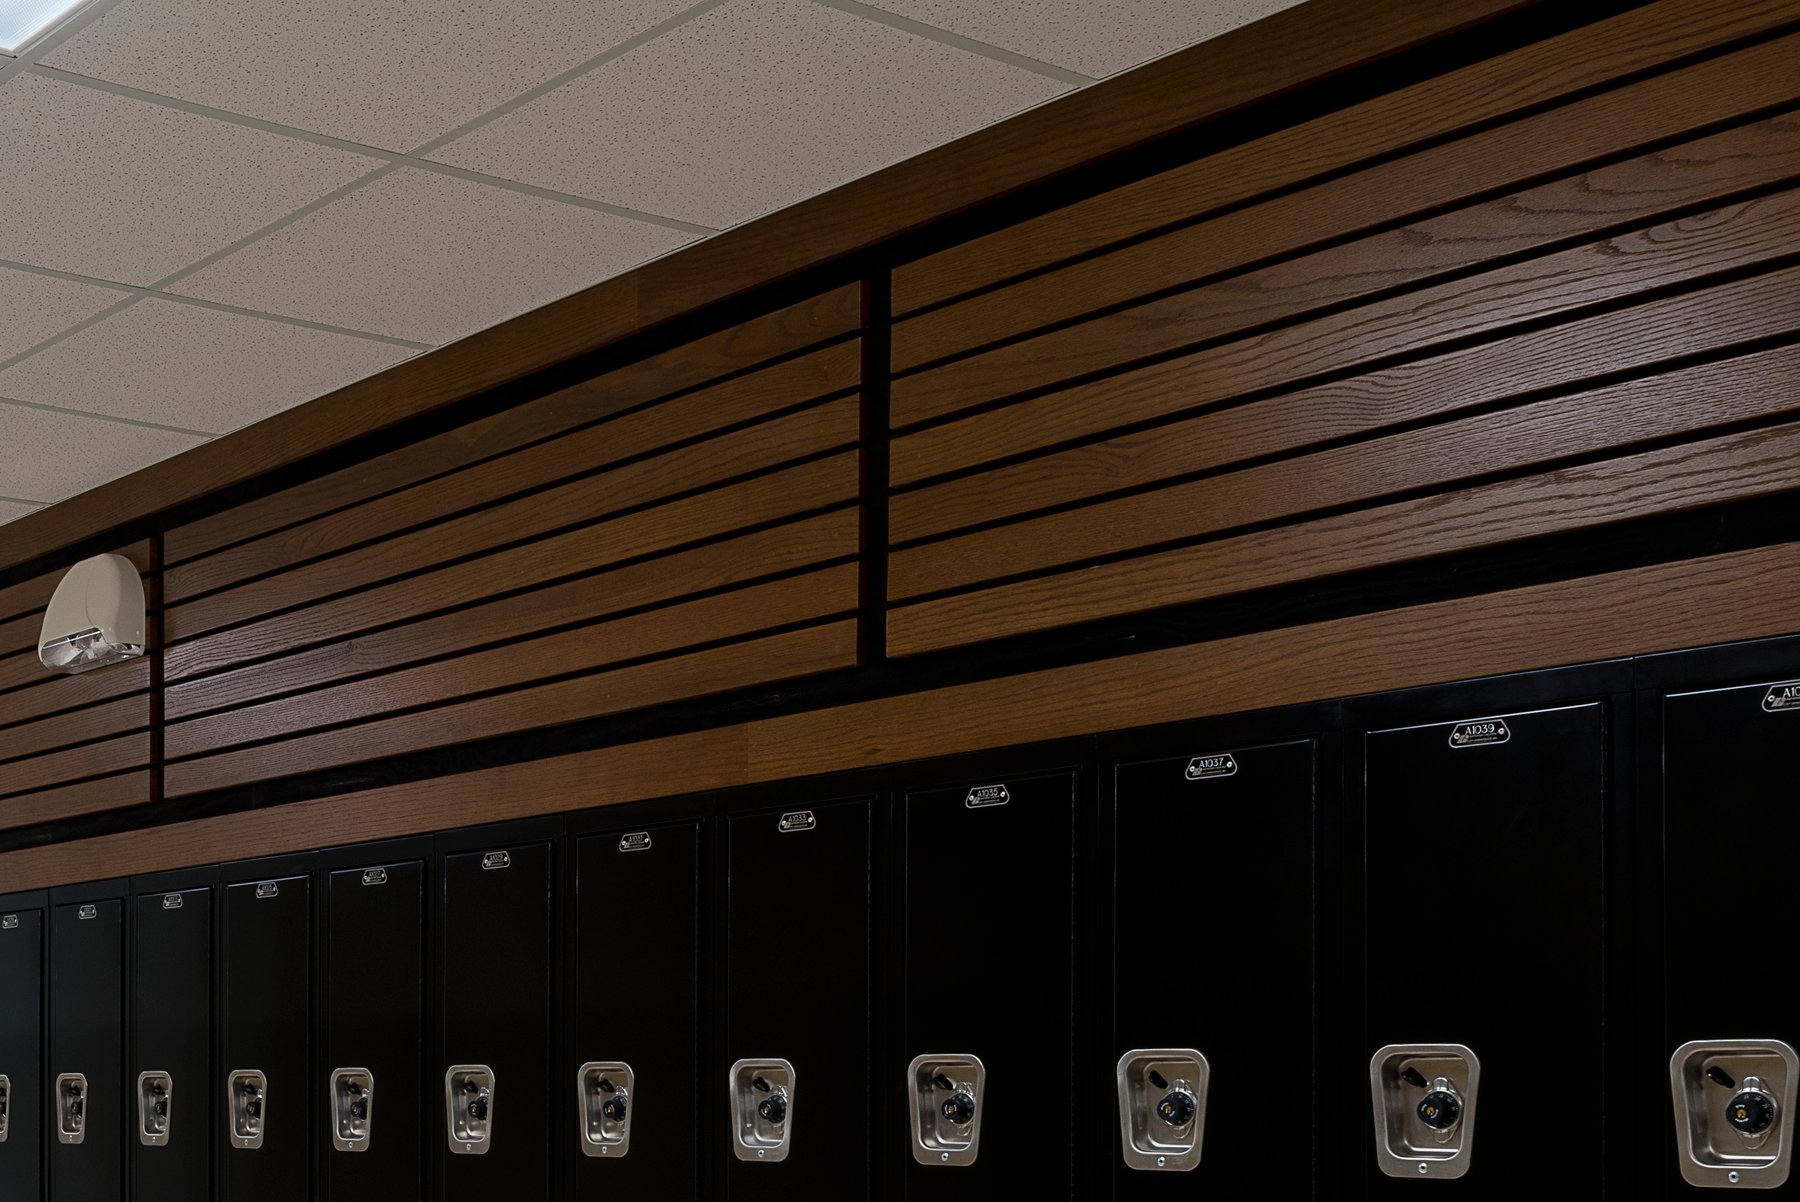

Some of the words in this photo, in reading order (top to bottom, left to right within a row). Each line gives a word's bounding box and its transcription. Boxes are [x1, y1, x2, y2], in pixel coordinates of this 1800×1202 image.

[1465, 723, 1494, 735] A1039
[1199, 758, 1224, 768] A1037
[978, 788, 998, 797] A1035
[788, 814, 806, 822] A1033
